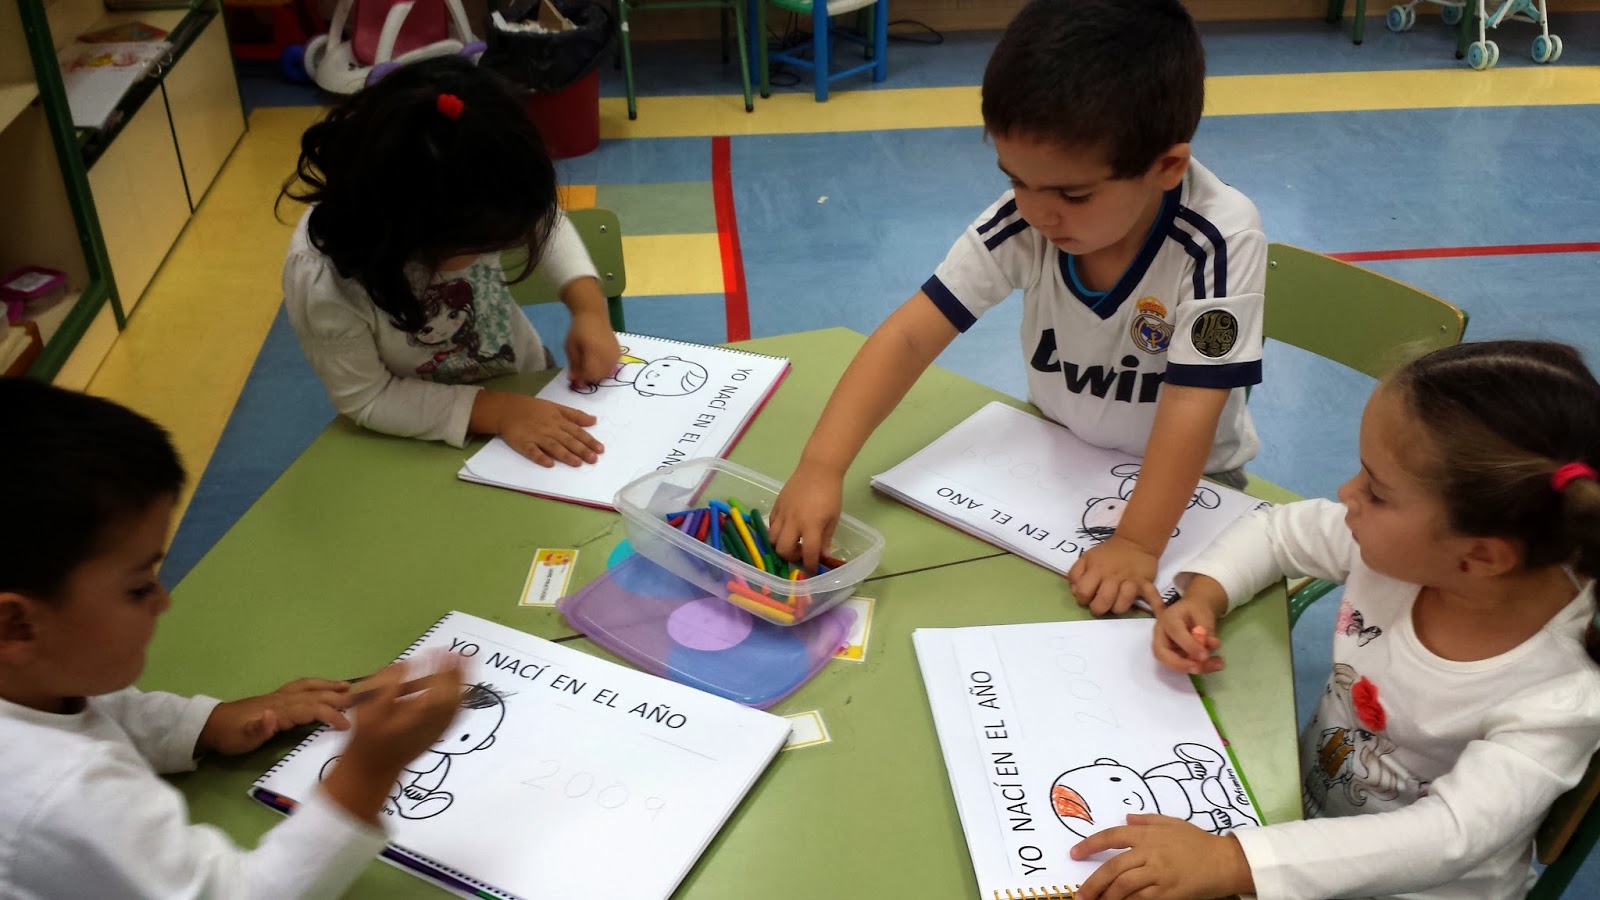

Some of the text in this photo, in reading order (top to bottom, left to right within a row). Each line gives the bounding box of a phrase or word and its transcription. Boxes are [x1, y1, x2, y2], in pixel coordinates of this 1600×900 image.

[731, 369, 753, 381] YO
[707, 385, 739, 411] NACÍ
[692, 413, 716, 428] EN
[678, 432, 701, 444] EL
[936, 487, 984, 510] AÑO
[990, 508, 1013, 525] EL
[1018, 523, 1050, 541] EN
[448, 637, 688, 730] YO NACÍ EN EL AÑO
[968, 670, 1001, 710] AÑO
[983, 719, 1009, 739] EL
[991, 752, 1019, 776] EN
[520, 759, 667, 823] 2009
[1017, 844, 1047, 876] YO
